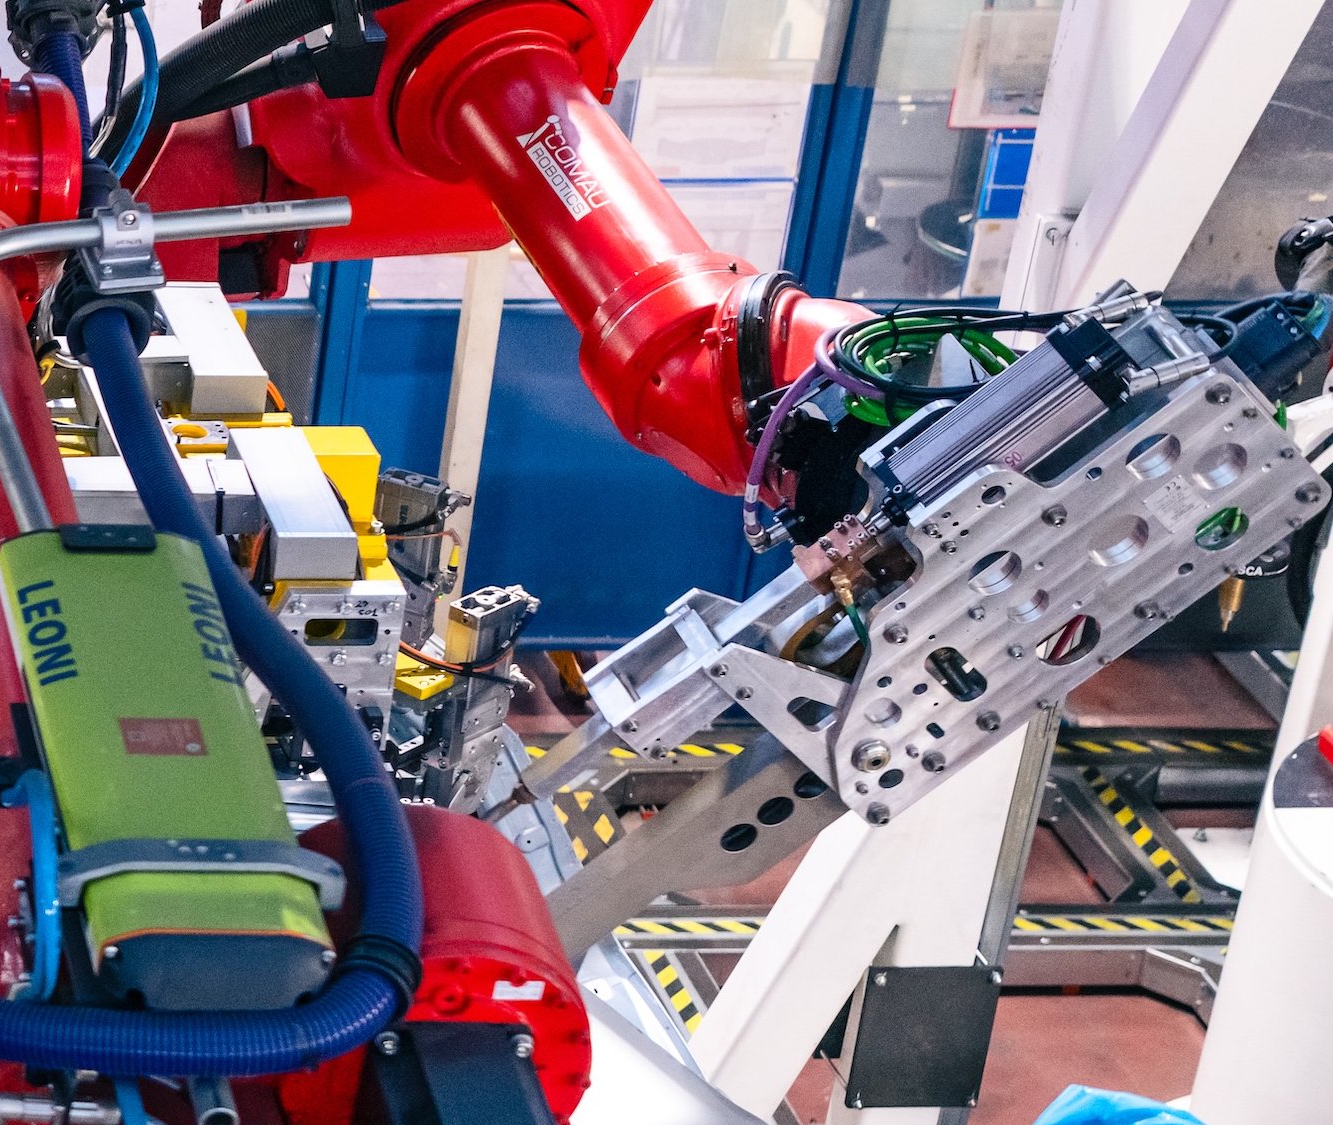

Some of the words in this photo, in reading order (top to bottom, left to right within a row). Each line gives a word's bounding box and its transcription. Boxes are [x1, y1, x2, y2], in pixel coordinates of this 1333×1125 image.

[532, 146, 586, 215] ROBOTICS
[544, 133, 611, 209] COMAU
[17, 579, 79, 688] LEONI
[181, 581, 245, 689] LEONI
